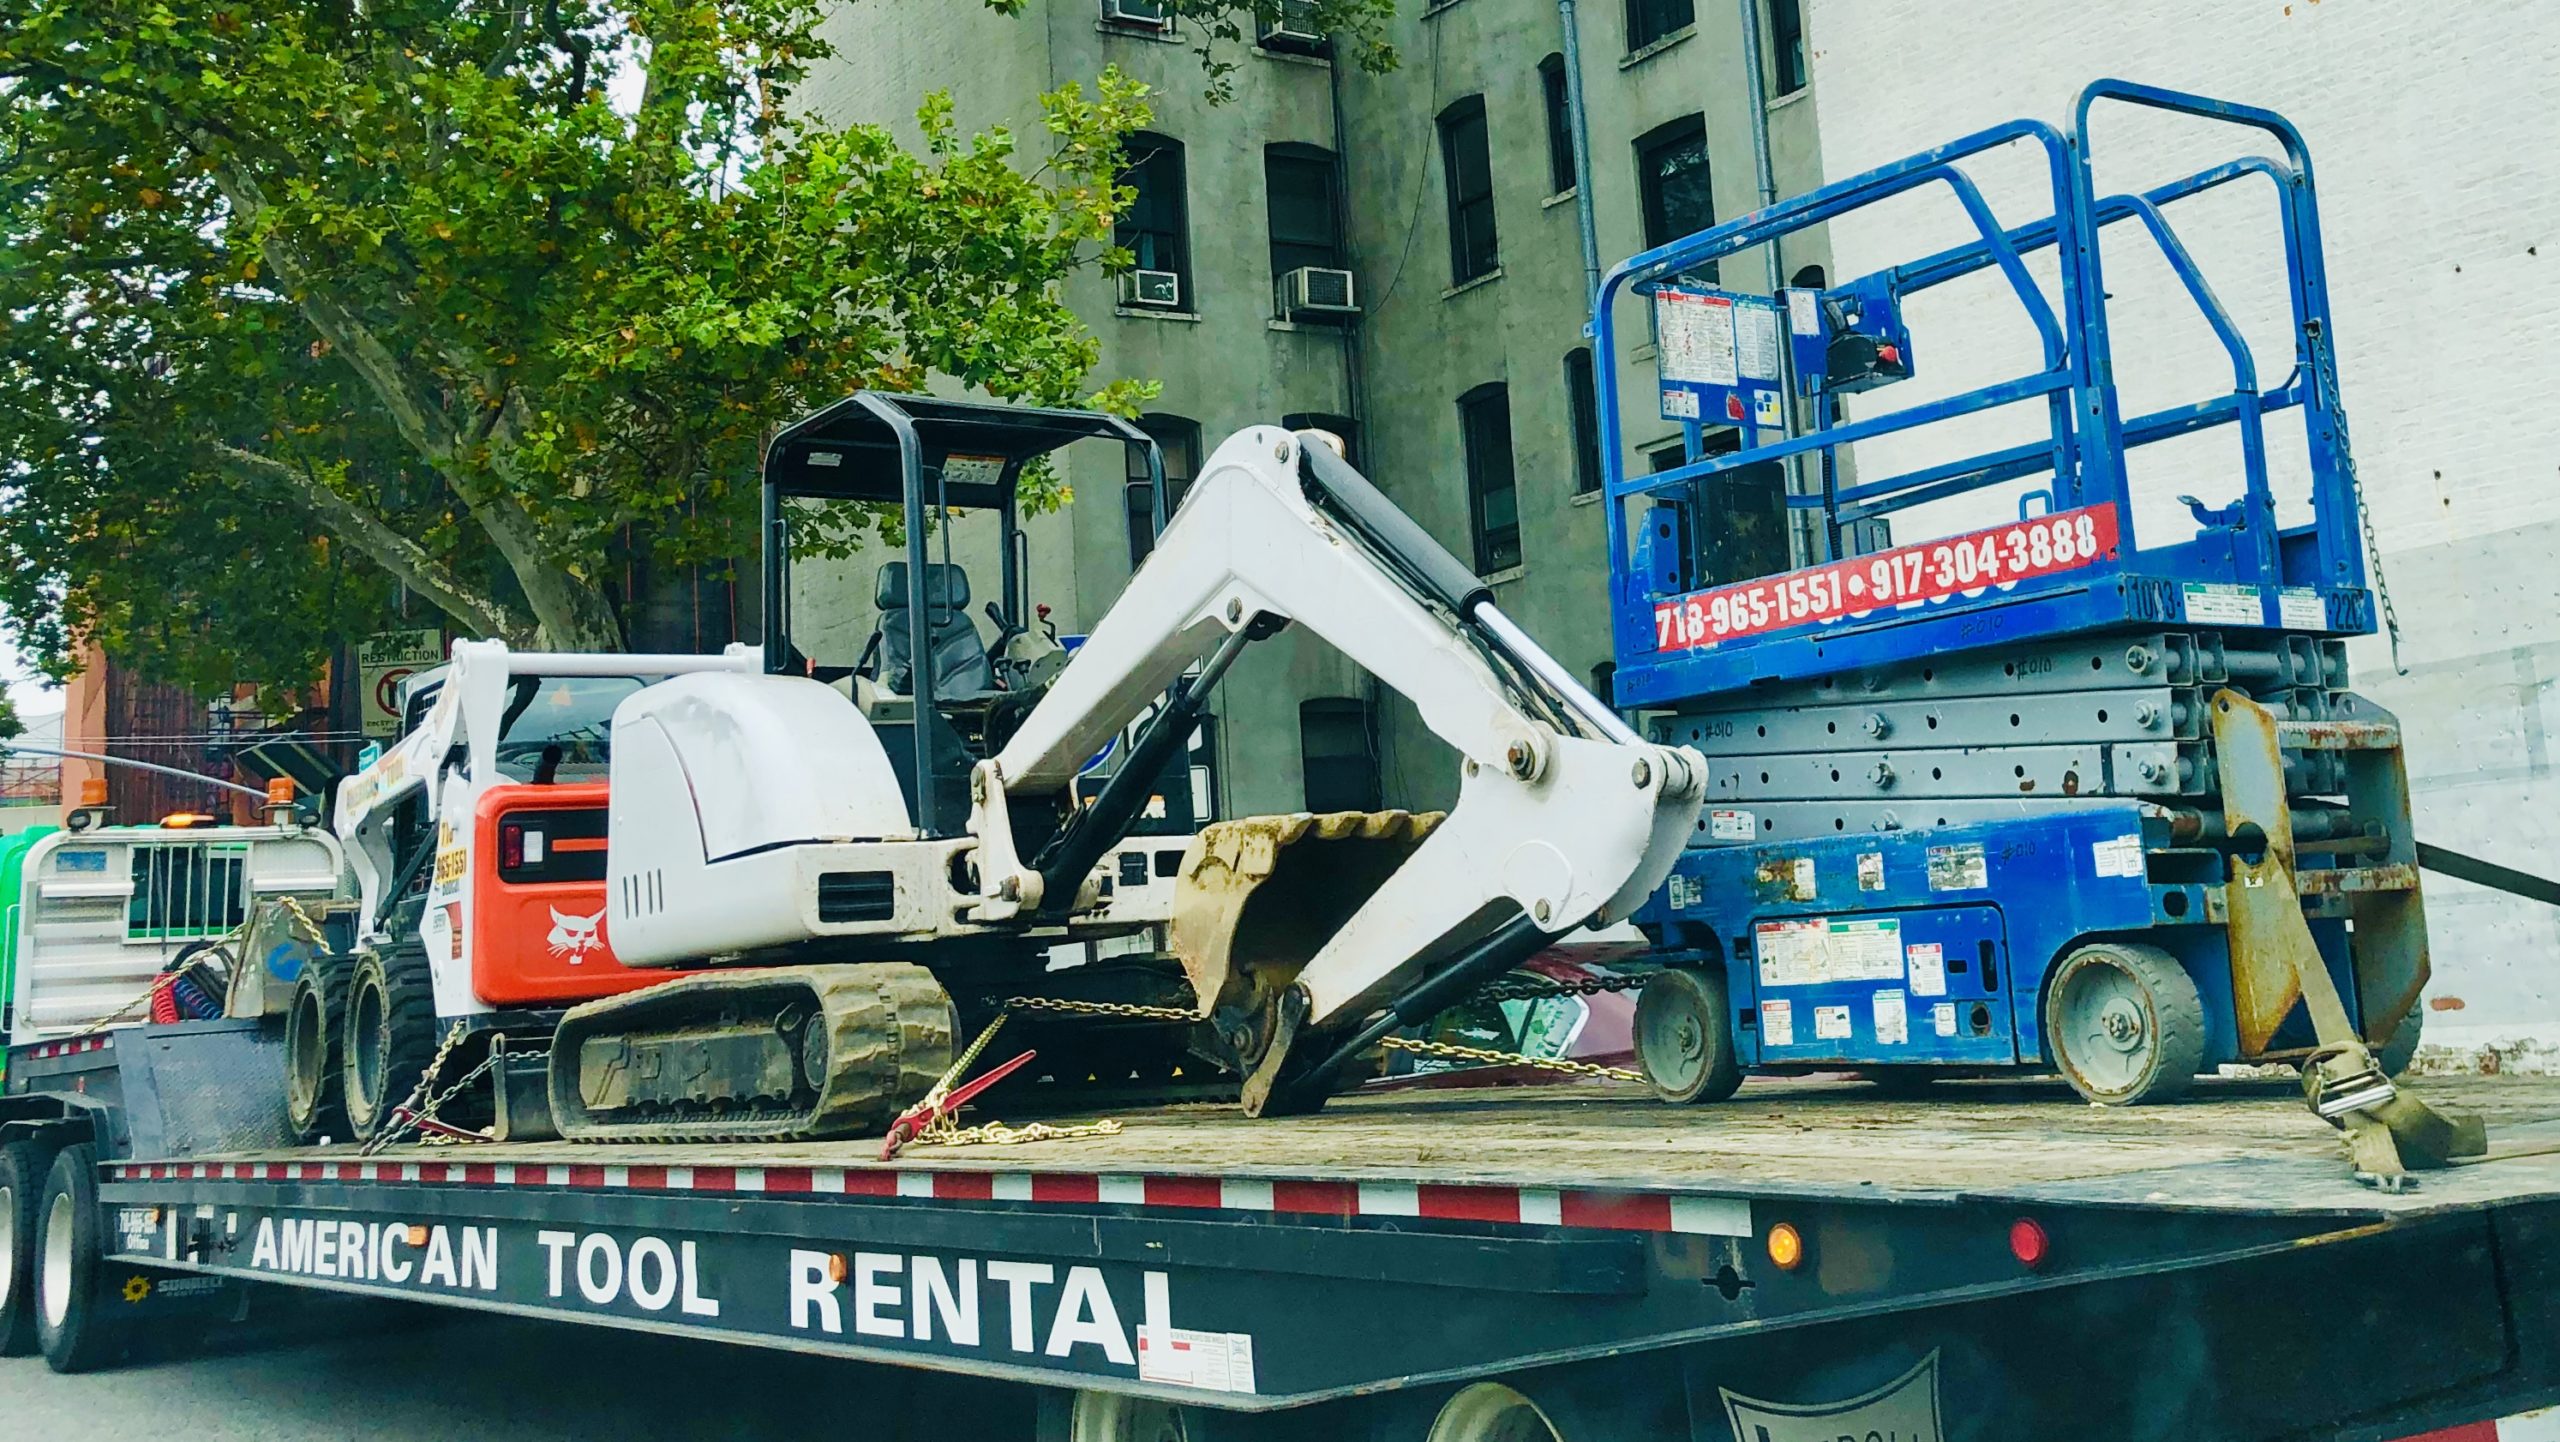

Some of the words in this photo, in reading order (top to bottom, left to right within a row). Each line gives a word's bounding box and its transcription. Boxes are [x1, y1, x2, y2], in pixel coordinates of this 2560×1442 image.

[1655, 570, 1842, 648] 718-965-1551
[1871, 513, 2098, 601] 917-304-3888
[251, 1216, 498, 1291] AMERICAN
[537, 1230, 720, 1317] TOOL
[789, 1249, 1191, 1372] RENTAL
